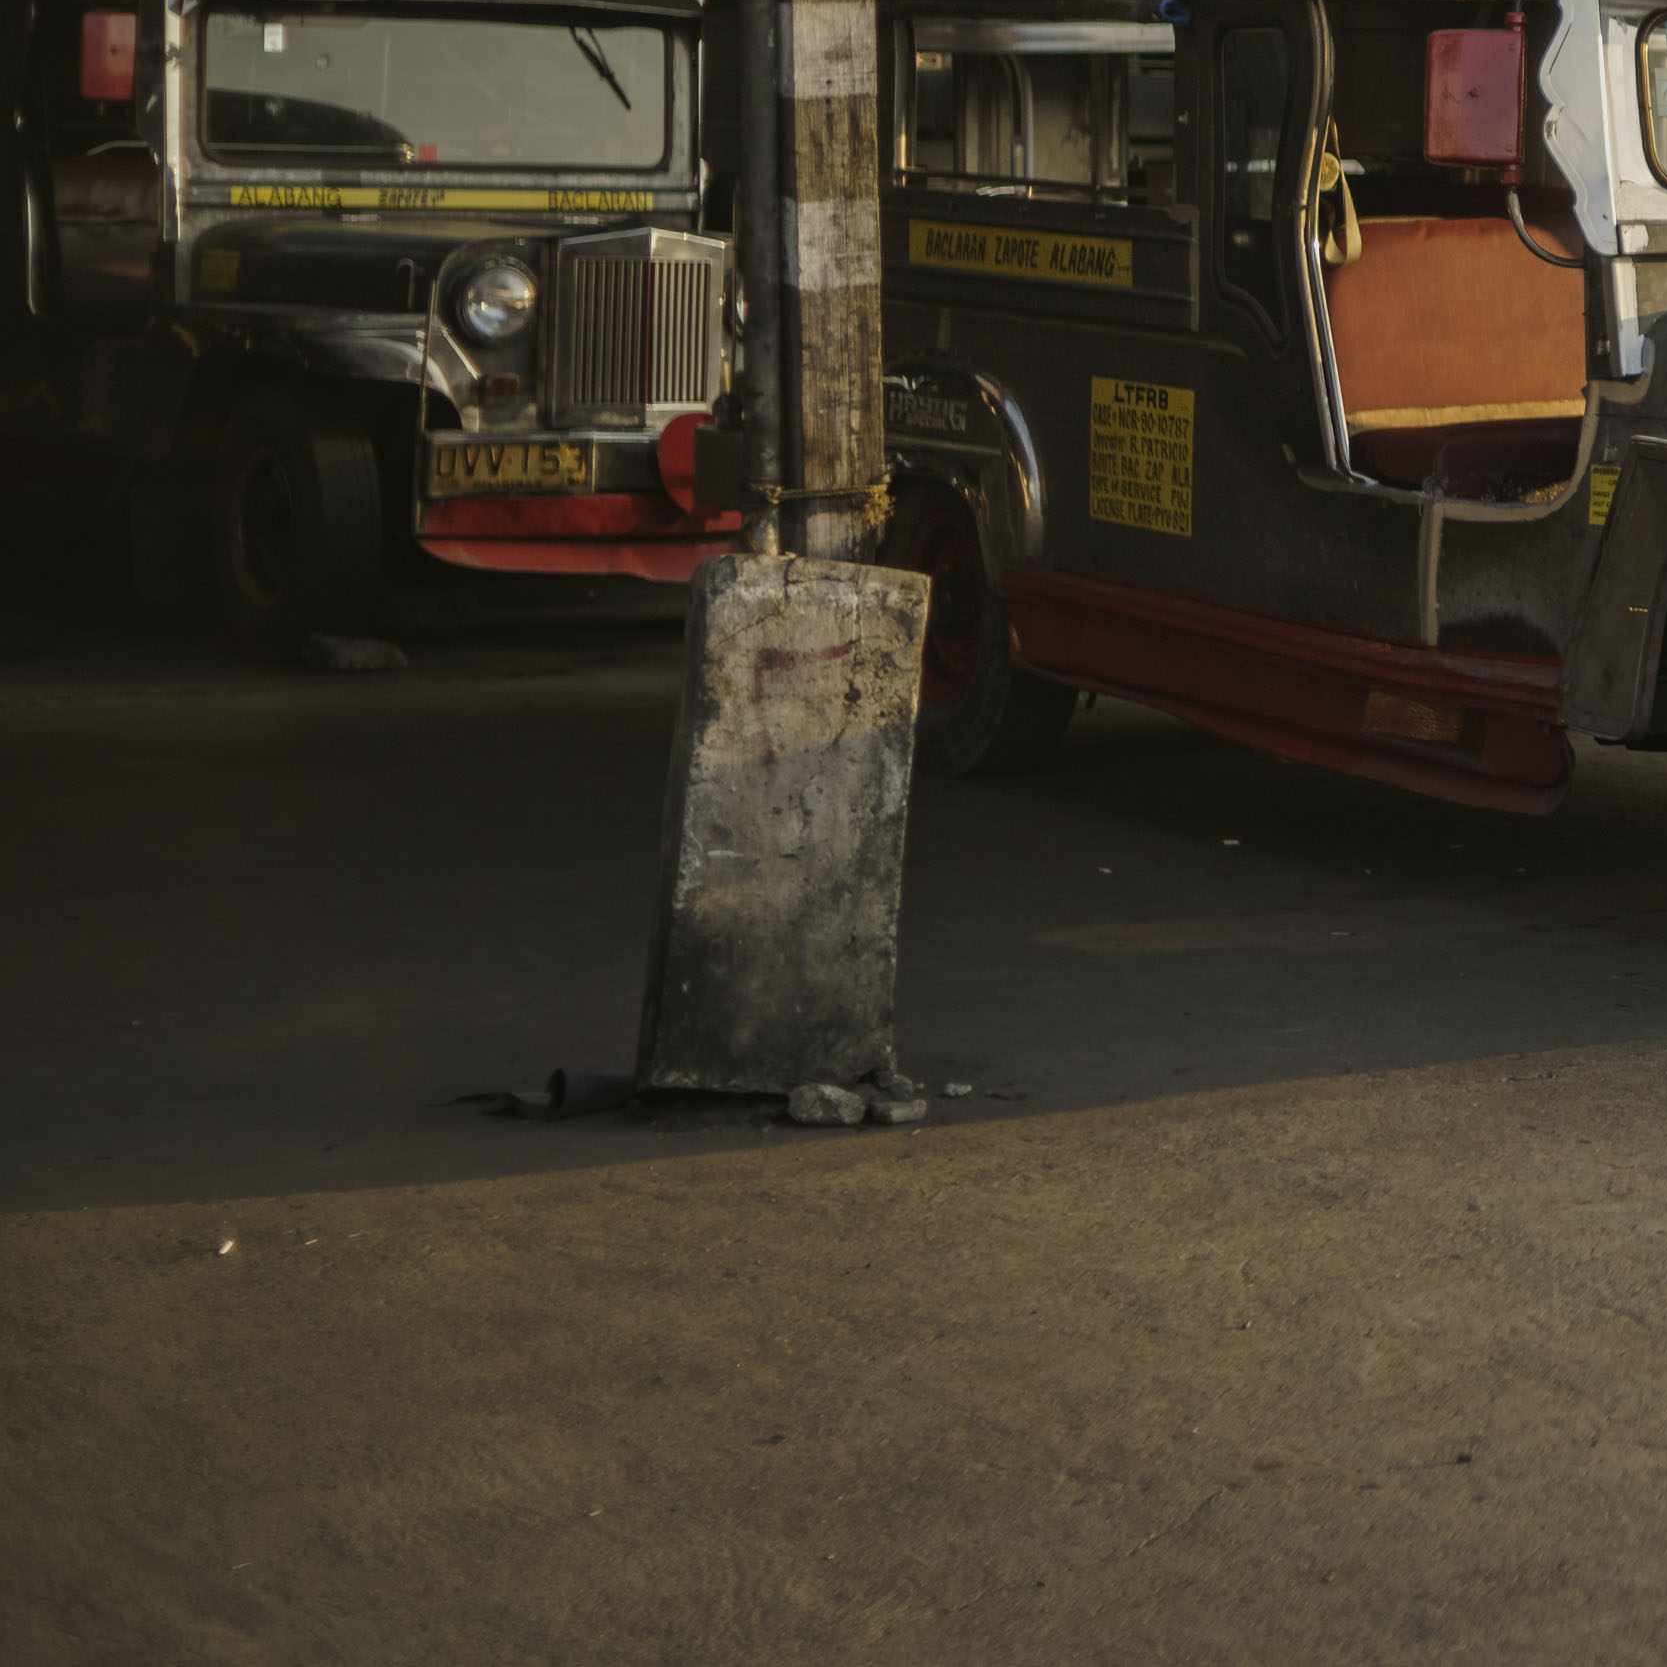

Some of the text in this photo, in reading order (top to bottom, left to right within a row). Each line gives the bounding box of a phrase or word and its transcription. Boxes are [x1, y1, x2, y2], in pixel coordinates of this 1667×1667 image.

[239, 186, 342, 208] ALABANG
[548, 190, 647, 212] BACLARAN
[926, 228, 1116, 278] BACLARAN ZAPOTE ALABANG
[1114, 383, 1169, 411] LTFRB
[1121, 480, 1162, 504] SERVICE
